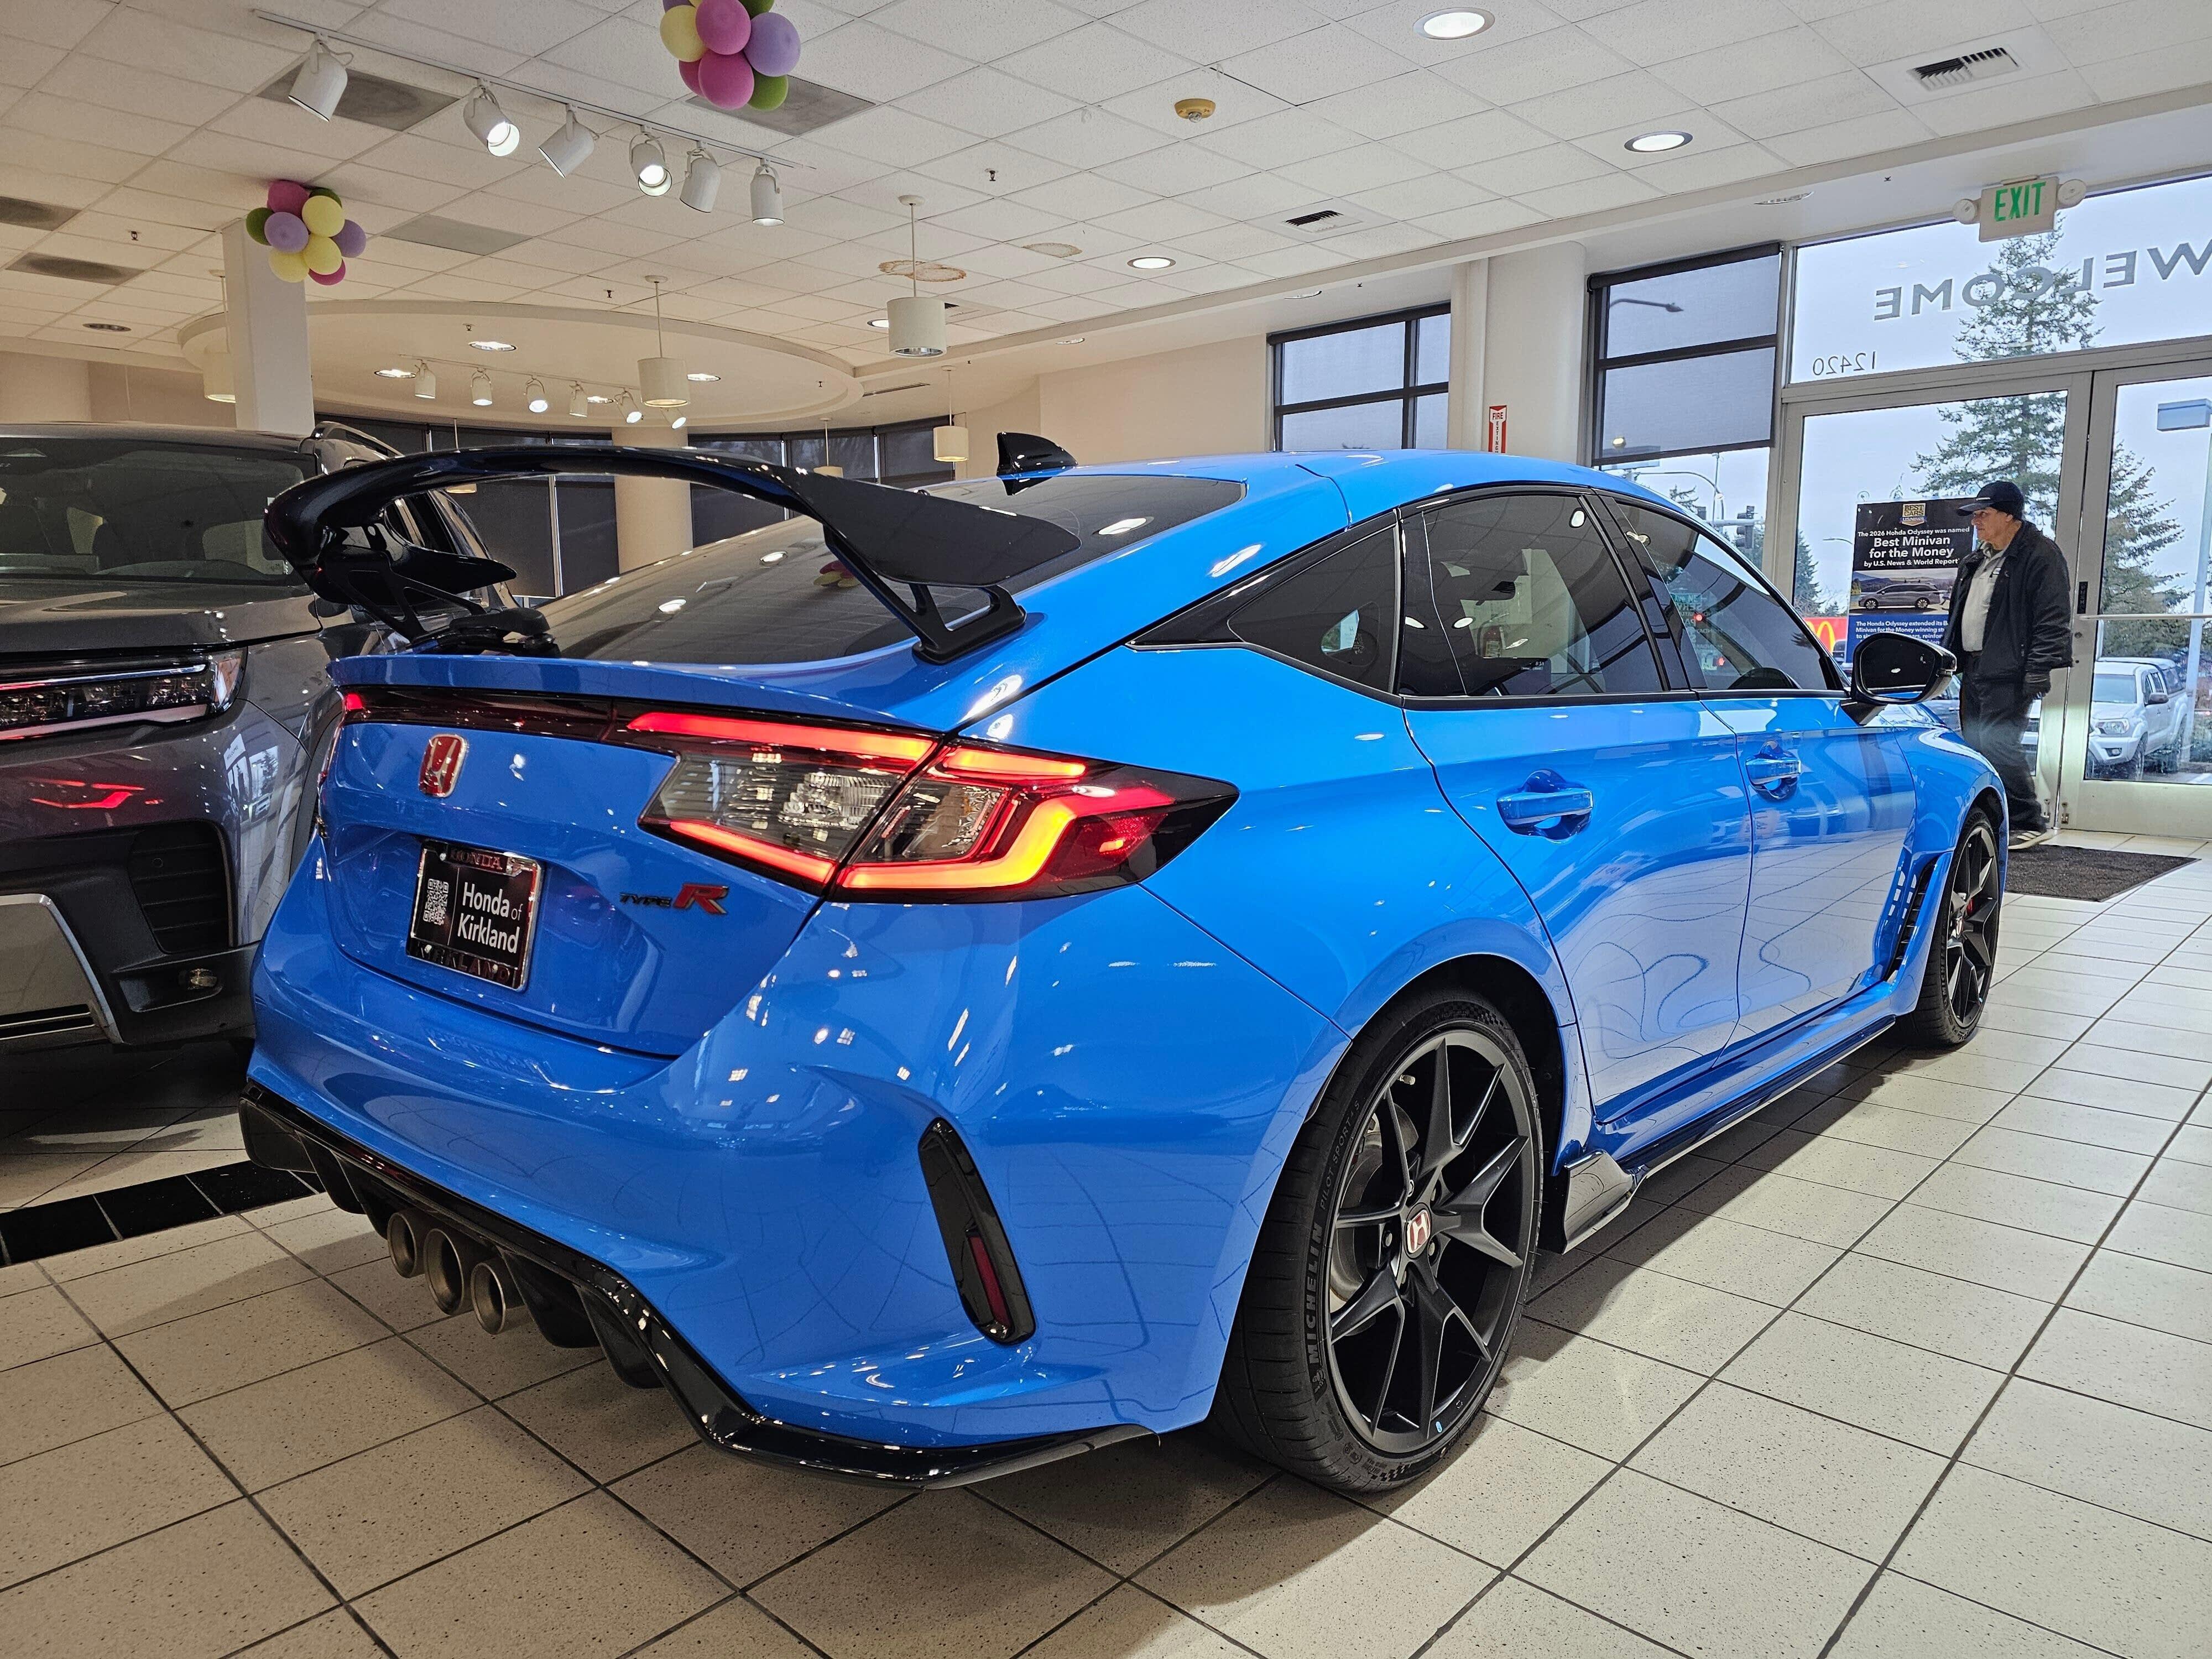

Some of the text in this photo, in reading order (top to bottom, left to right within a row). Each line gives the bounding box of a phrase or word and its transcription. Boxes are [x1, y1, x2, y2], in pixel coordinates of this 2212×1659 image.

[1994, 181, 2047, 221] EXIT
[1869, 547, 1954, 559] for the Money
[1874, 535, 1950, 547] Best Minivan
[462, 881, 523, 921] Honda of
[619, 883, 729, 915] TYPE R
[457, 913, 520, 953] Kirkland
[1306, 1221, 1323, 1364] MICHELIN
[1320, 1167, 1334, 1210] PILOT
[1333, 1117, 1351, 1164] SPORT
